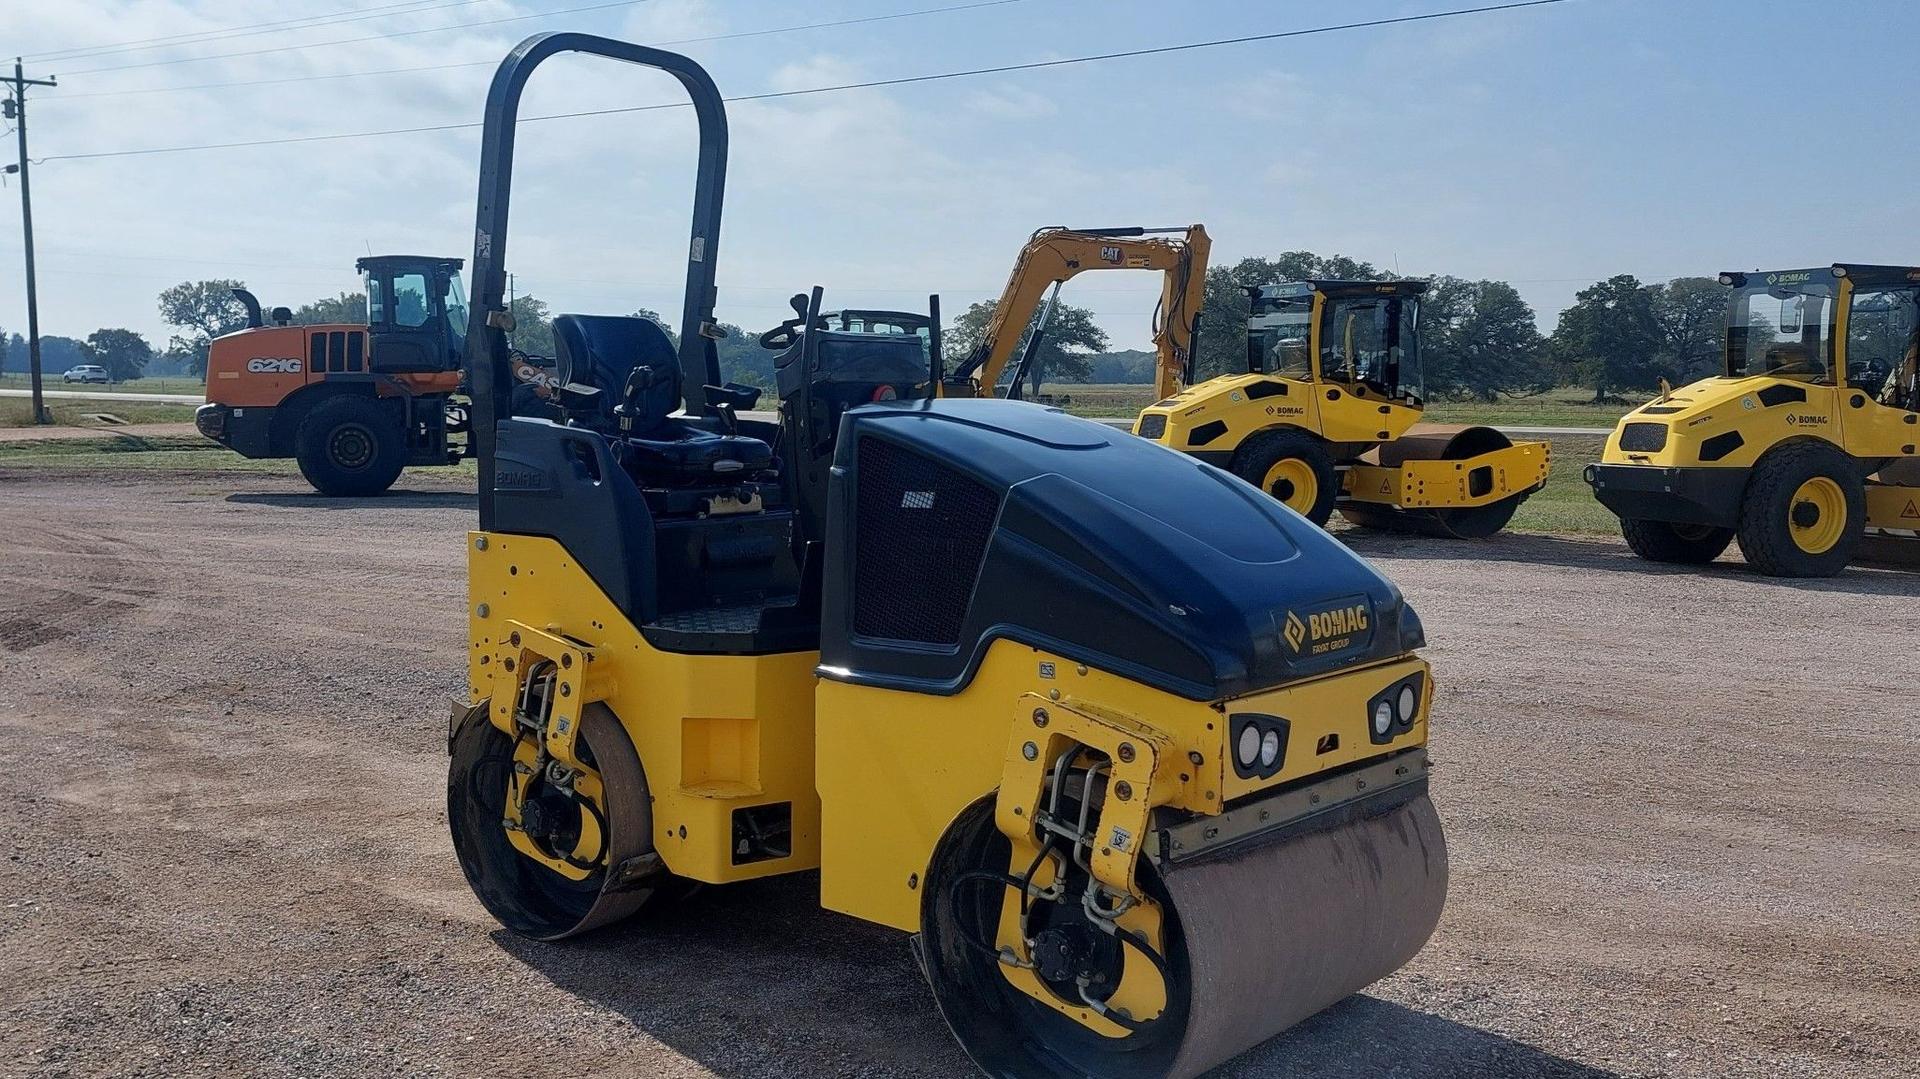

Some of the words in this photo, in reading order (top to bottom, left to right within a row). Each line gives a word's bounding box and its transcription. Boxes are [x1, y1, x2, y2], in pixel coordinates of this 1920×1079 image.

[1101, 246, 1120, 261] CAT
[1779, 272, 1810, 282] BOMAG
[248, 358, 302, 373] 621G
[1277, 406, 1304, 415] BOMAG
[1798, 415, 1828, 424] BOMAG
[1309, 605, 1367, 640] BOMAG
[1312, 643, 1330, 655] FAYAT
[1330, 638, 1350, 650] GROUP
